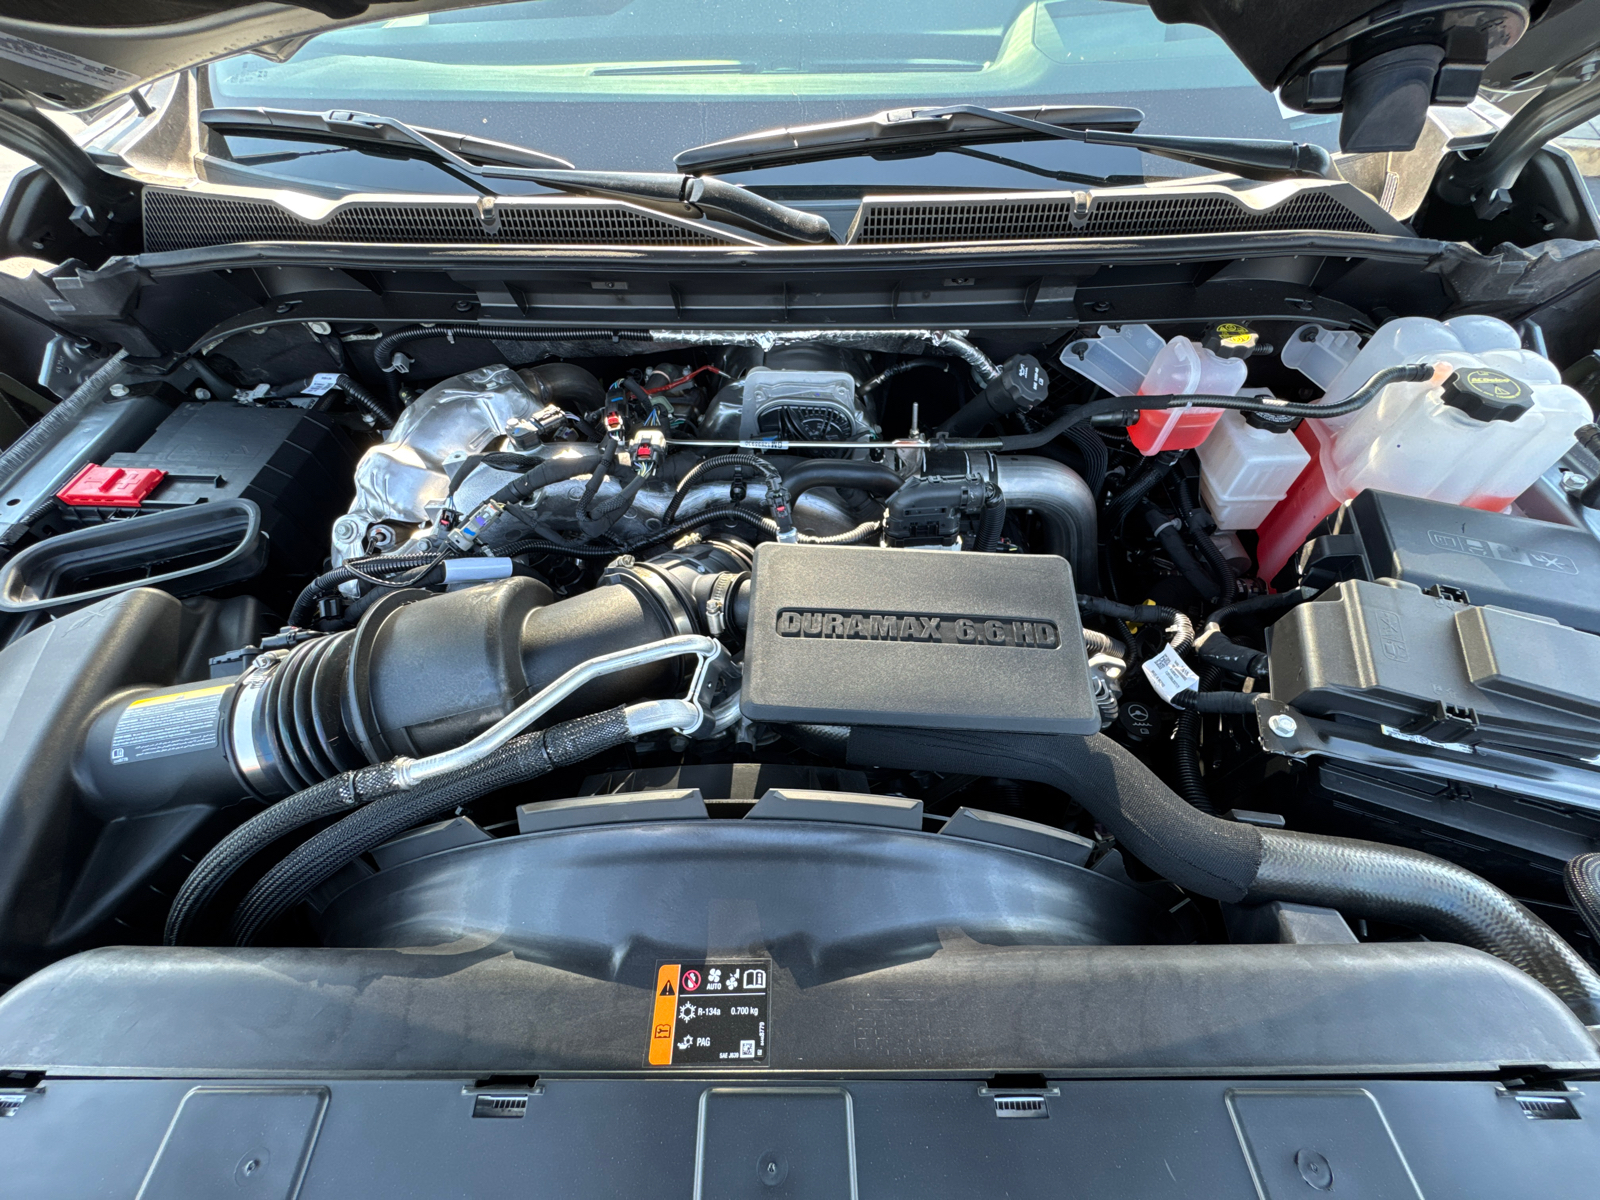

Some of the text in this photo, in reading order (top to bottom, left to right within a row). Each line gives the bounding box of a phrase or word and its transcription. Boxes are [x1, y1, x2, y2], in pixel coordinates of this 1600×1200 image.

[779, 611, 1058, 647] DURAMAX 6.6 HD
[697, 1006, 759, 1016] R-134a 0.700 kg
[697, 1037, 711, 1047] PAG
